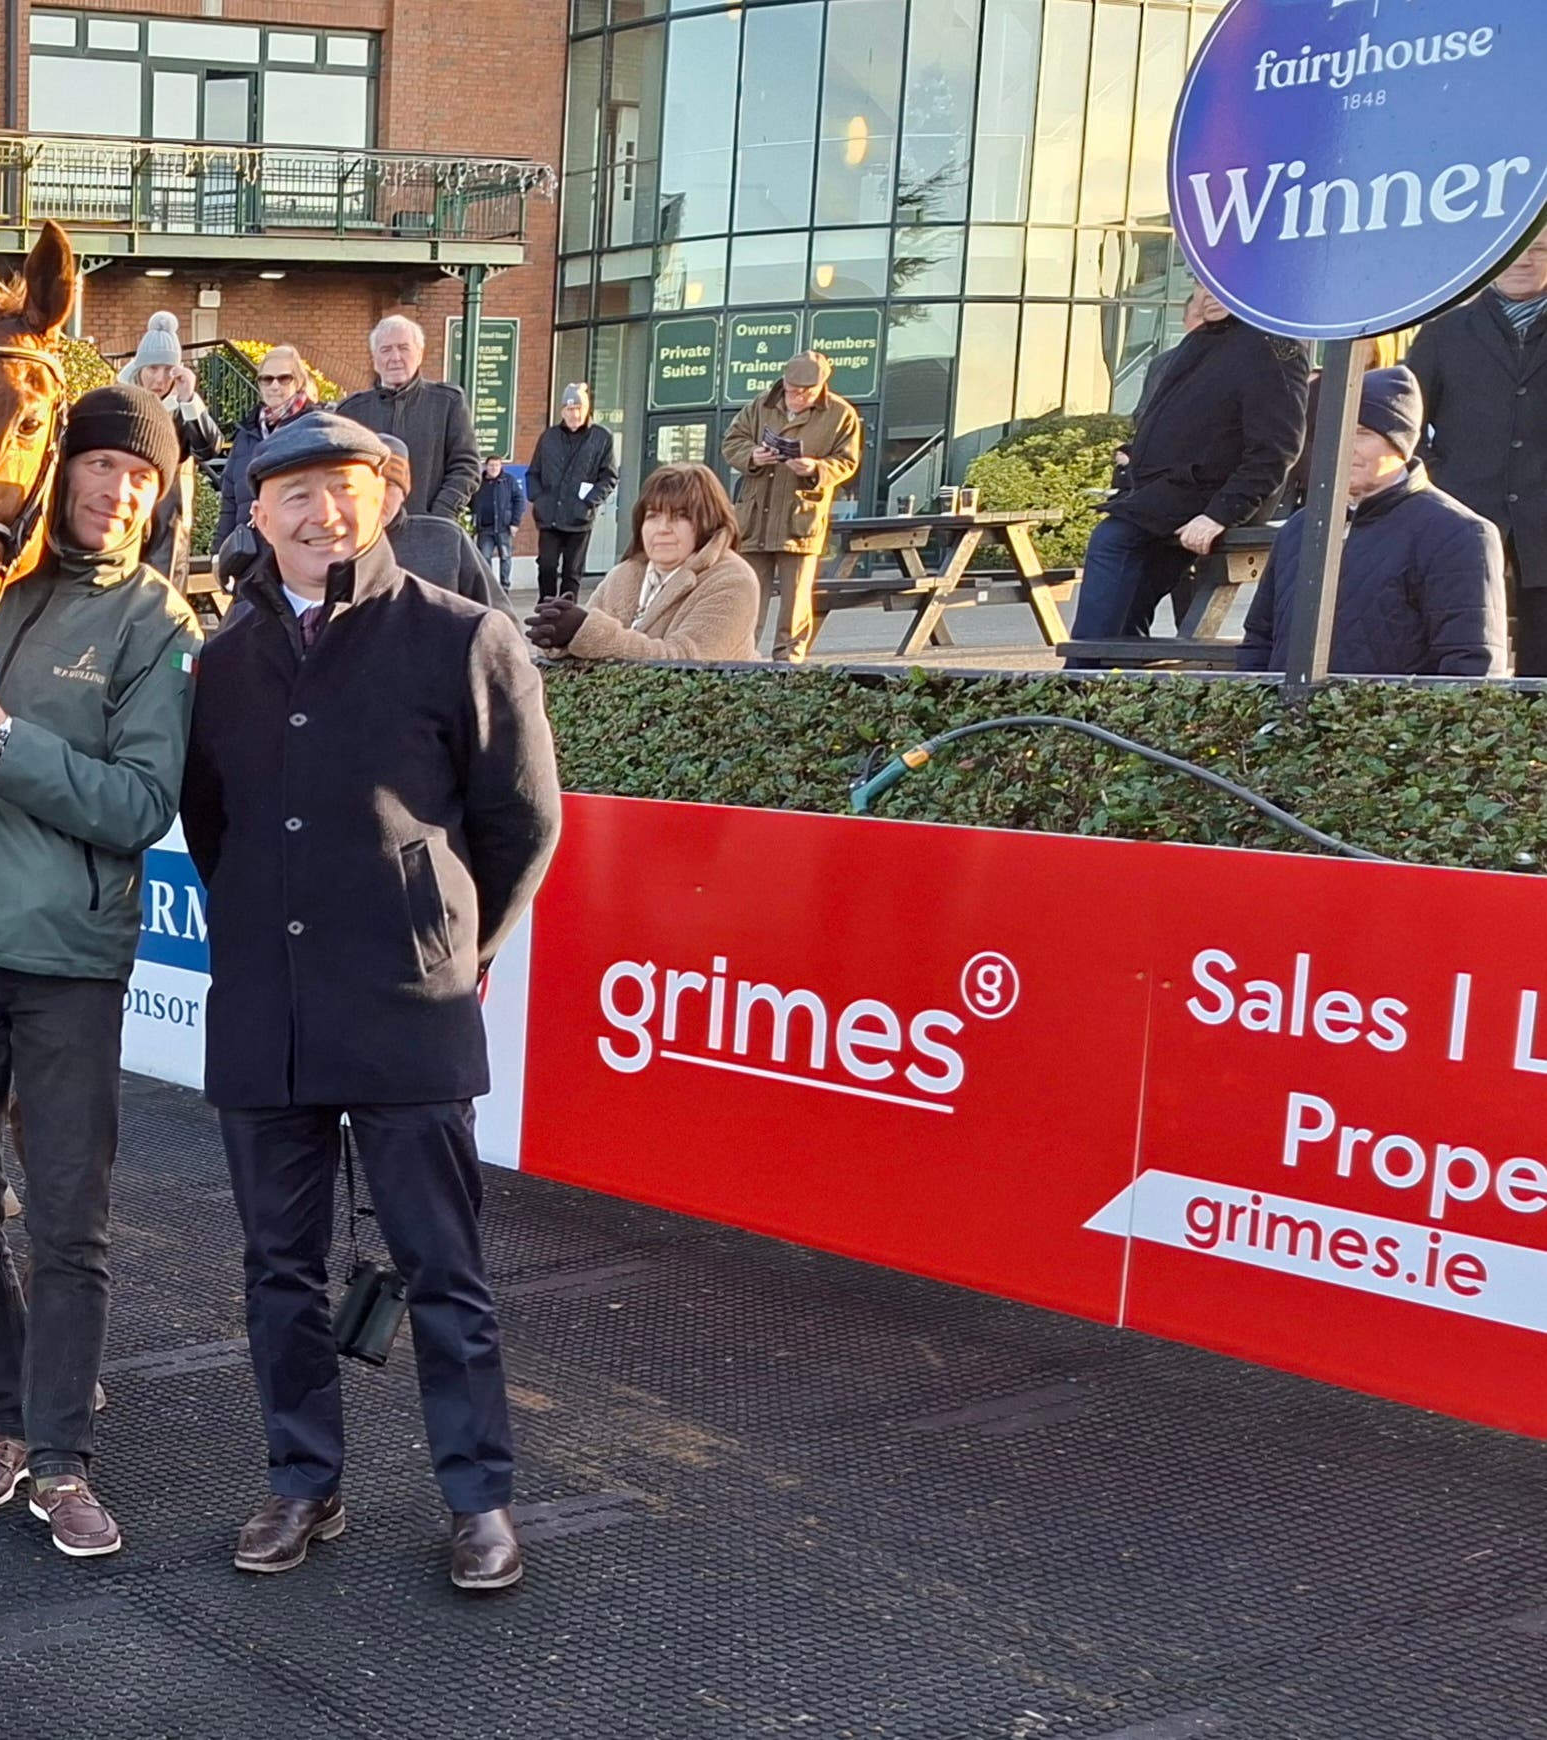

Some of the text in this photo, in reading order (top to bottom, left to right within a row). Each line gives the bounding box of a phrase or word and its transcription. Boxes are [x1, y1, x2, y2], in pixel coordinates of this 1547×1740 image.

[1254, 25, 1494, 91] fairyhouse
[1342, 89, 1387, 111] 1848
[1188, 155, 1531, 248] Winner
[736, 323, 792, 337] Owners
[756, 341, 769, 355] &
[813, 336, 877, 351] Members
[660, 345, 711, 360] Private
[731, 359, 785, 374] Trainer
[826, 356, 868, 369] ounge
[662, 364, 707, 379] Suites
[1187, 948, 1409, 1052] Sales
[598, 956, 965, 1093] grimes
[1184, 1194, 1488, 1297] grimes.ie
